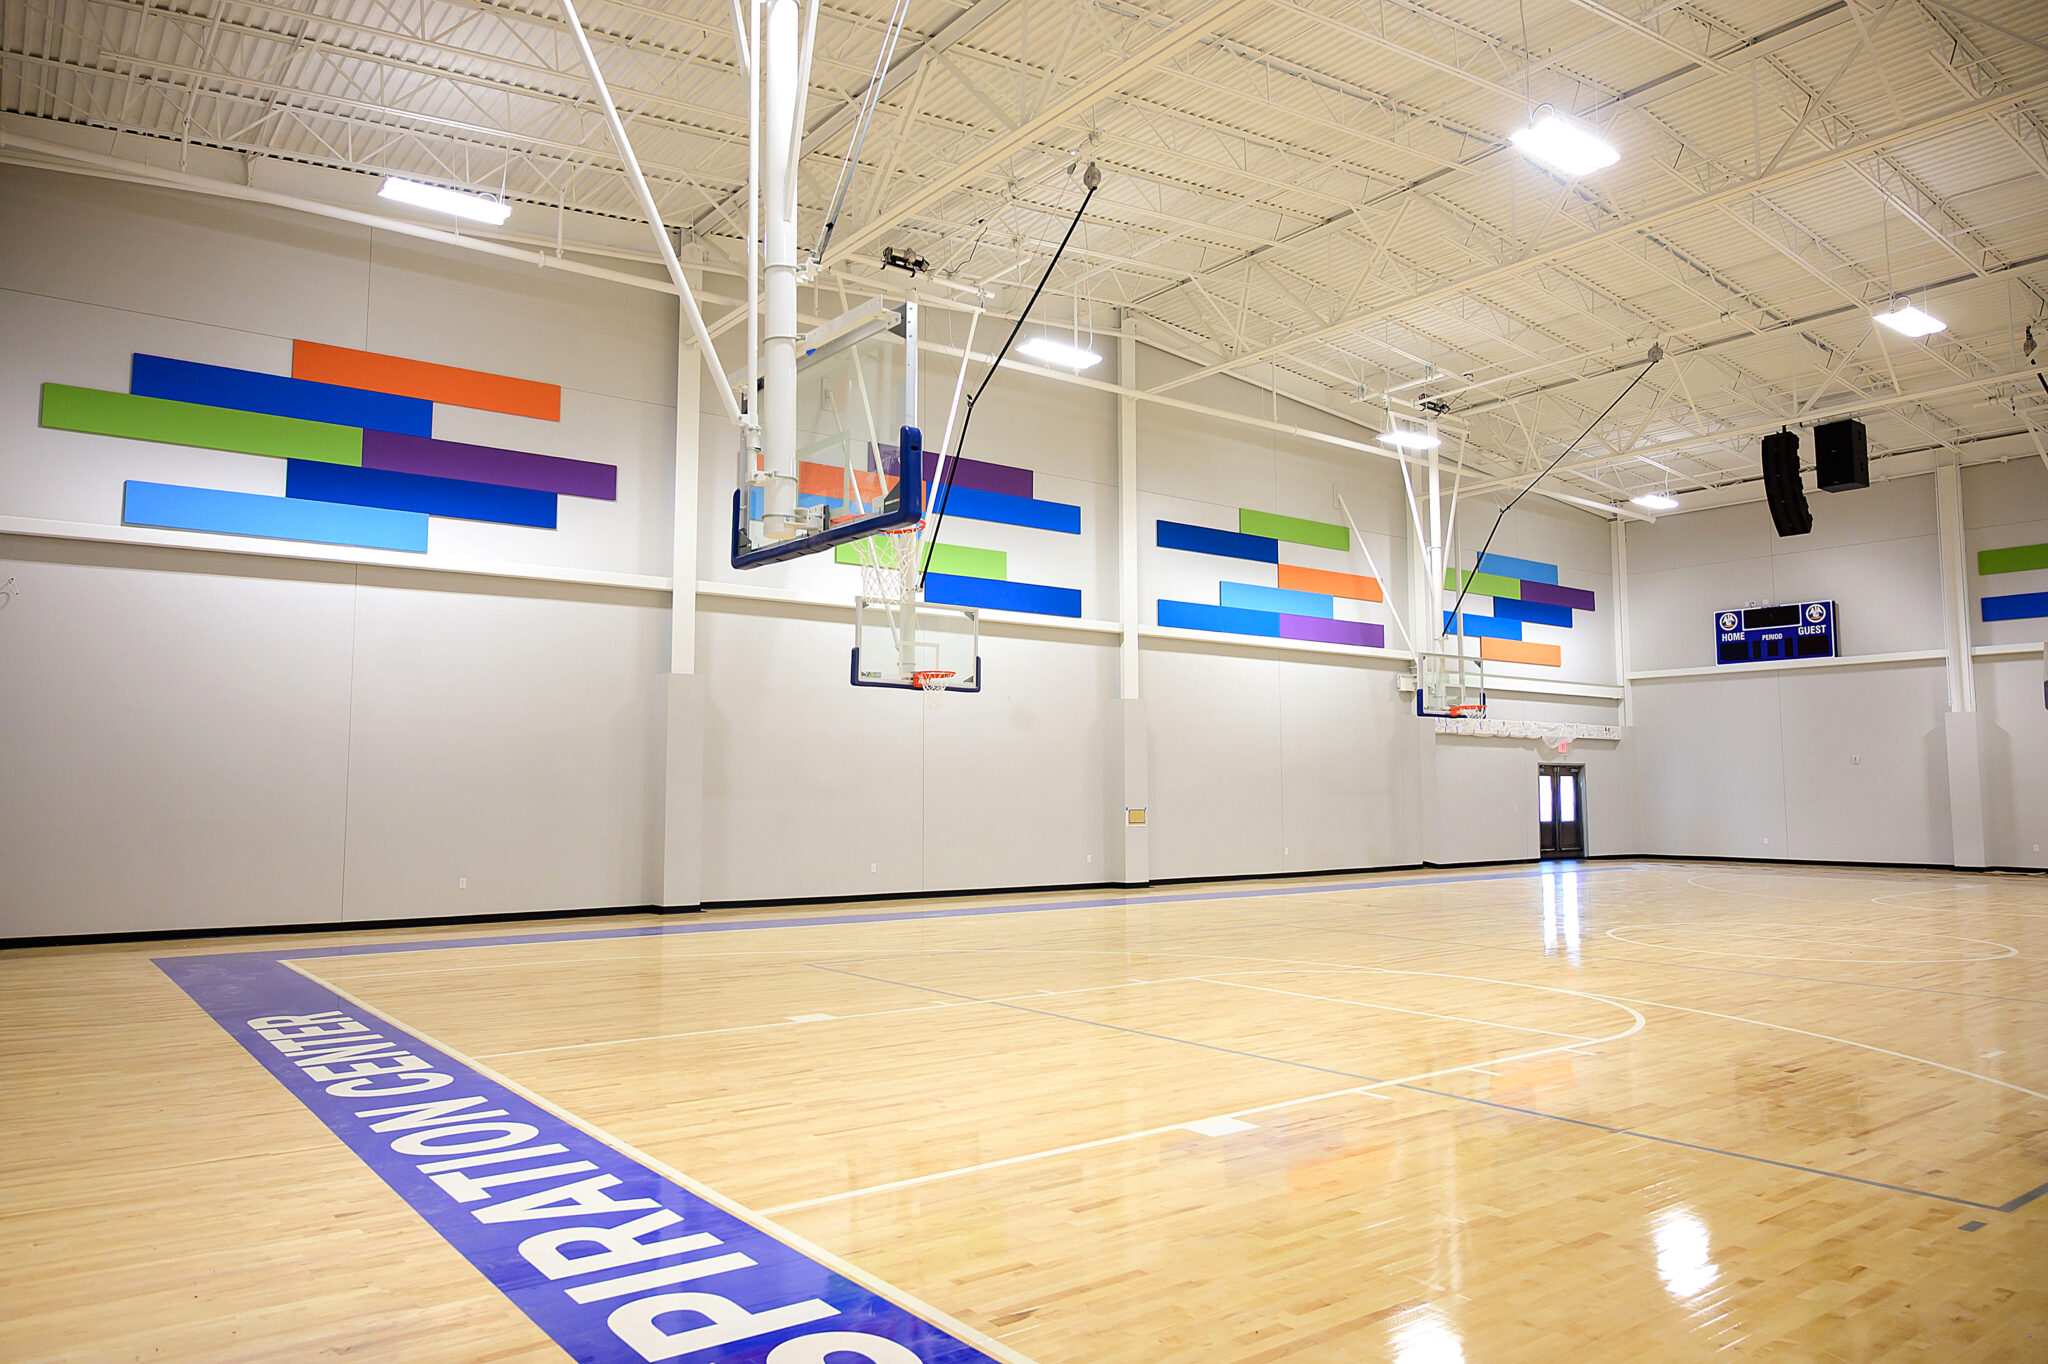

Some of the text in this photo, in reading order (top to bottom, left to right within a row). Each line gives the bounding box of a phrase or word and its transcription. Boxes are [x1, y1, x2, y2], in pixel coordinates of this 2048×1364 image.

[1797, 624, 1827, 636] GUEST
[1721, 631, 1746, 642] HOME
[1761, 633, 1783, 641] PERIOD
[246, 1010, 455, 1098] CENTER
